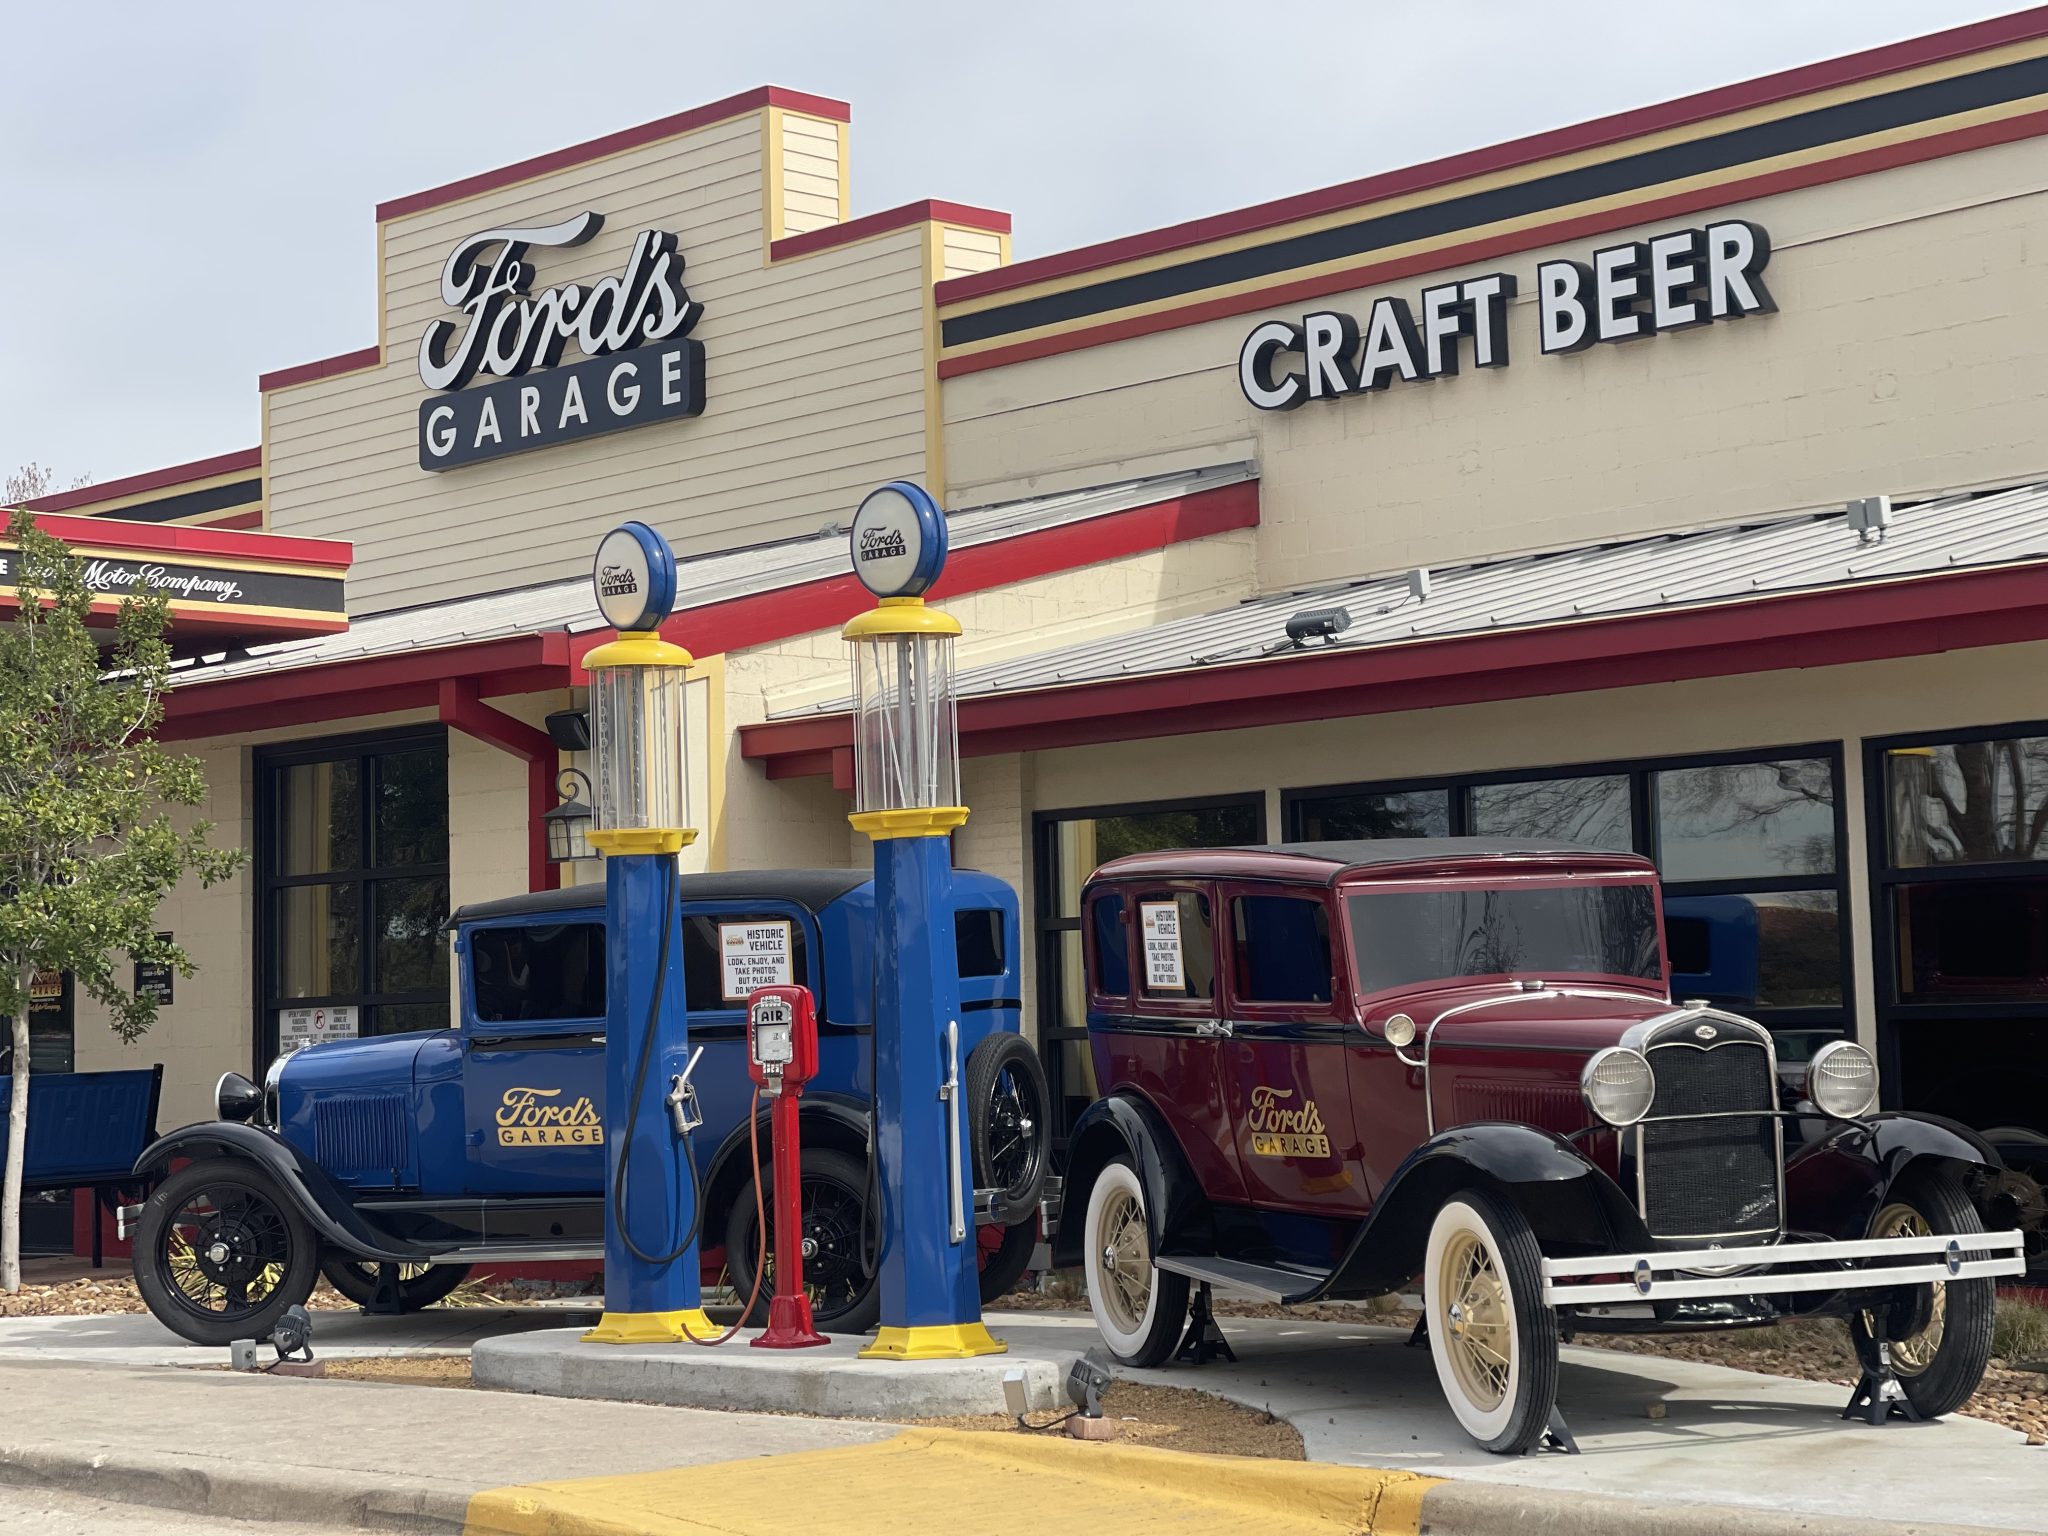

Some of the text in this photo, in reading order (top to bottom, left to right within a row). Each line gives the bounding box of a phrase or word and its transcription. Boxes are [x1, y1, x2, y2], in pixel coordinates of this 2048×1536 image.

[418, 211, 702, 391] Ford's
[1239, 220, 1777, 411] CRAFT BEER
[426, 351, 682, 457] GARAGE
[860, 526, 904, 549] Ford's
[862, 546, 905, 560] GARAGE
[601, 565, 635, 585] Ford's
[140, 564, 243, 601] Company
[602, 584, 637, 596] GARAGE
[1155, 910, 1176, 921] HISTORIC
[747, 929, 784, 940] HISTORIC
[1158, 924, 1176, 934] VEHICLE
[750, 940, 783, 951] VEHICLE
[728, 956, 784, 966] LOOK, ENJOY, AND
[1152, 953, 1160, 961] TAKE
[735, 966, 779, 975] TAKE PHOTOS,
[1162, 964, 1174, 972] PLEASE
[738, 976, 775, 984] BUT PLEASE
[32, 985, 61, 996] ARAGE
[735, 986, 743, 995] DO
[761, 1010, 783, 1022] AIR
[496, 1087, 601, 1127] Ford's
[1248, 1086, 1326, 1134] Ford's
[501, 1128, 601, 1144] GARAGE
[1255, 1136, 1328, 1154] GARAGE
